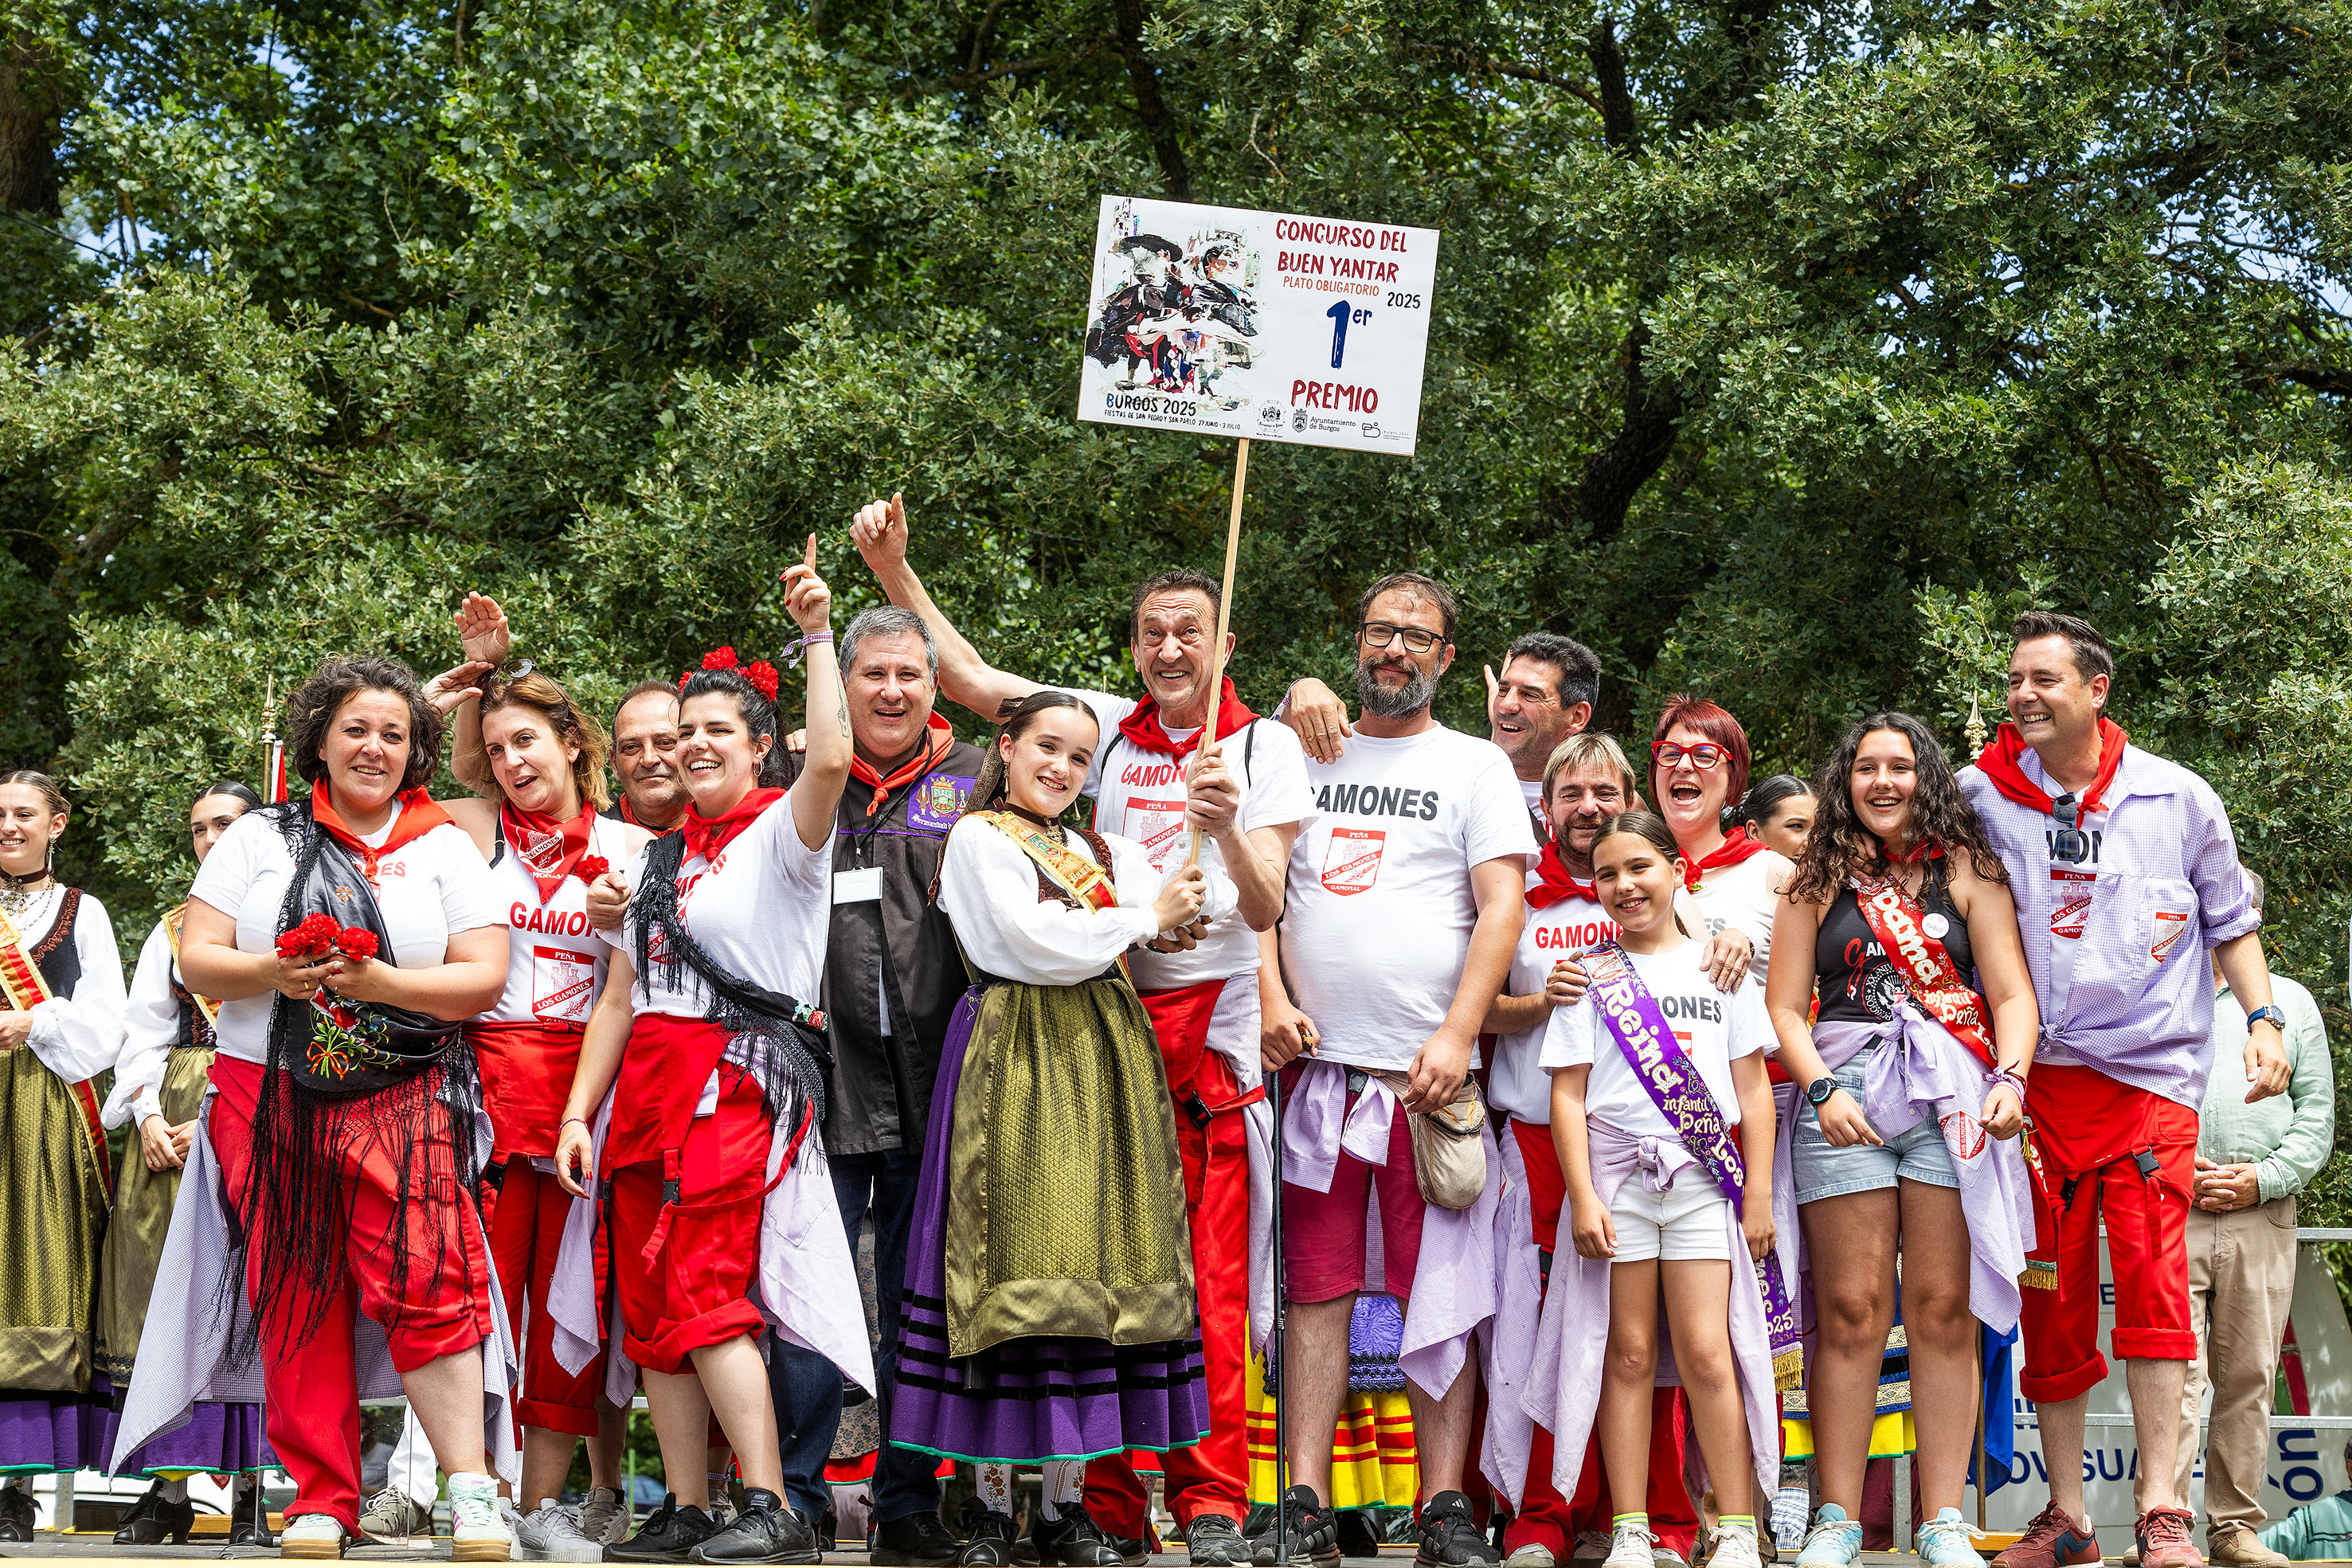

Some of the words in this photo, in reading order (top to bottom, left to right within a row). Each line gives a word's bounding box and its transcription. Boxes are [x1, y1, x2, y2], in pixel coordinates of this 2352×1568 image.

[1276, 219, 1376, 248] CONCURSO
[1380, 230, 1407, 252] DEL
[1278, 252, 1324, 275] BUEN
[1330, 256, 1399, 283] YANTAR
[1283, 276, 1313, 290] PLATO
[1316, 280, 1380, 296] OBLIGATORIO
[1387, 291, 1421, 309] 2025
[1106, 393, 1158, 413] BURGOS
[1163, 399, 1196, 416] 2025
[1291, 379, 1378, 413] PREMIO
[1105, 409, 1125, 418] FIESTAS
[1310, 416, 1356, 428] Ayuntamiento
[1121, 763, 1188, 787] GAMON
[1146, 800, 1167, 810] PEÑA
[1311, 784, 1438, 821] AMONES
[534, 836, 559, 854] AMONES
[1144, 827, 1178, 847] AMONES
[1325, 870, 1340, 879] LOS
[1341, 854, 1377, 871] GAMONES
[510, 901, 601, 939] GAMO
[1925, 922, 1944, 934] PABLO
[2050, 912, 2066, 924] LOS
[1872, 886, 1943, 986] Dama
[555, 952, 576, 961] PEÑA
[537, 998, 553, 1010] LOS
[555, 981, 590, 999] GAMONES
[1923, 989, 1973, 1008] infantil
[1654, 995, 1721, 1024] ONES
[1939, 1003, 1979, 1026] Peña
[1596, 976, 1685, 1095] Reina
[1663, 1094, 1709, 1115] infantil
[1676, 1111, 1721, 1134] Peña
